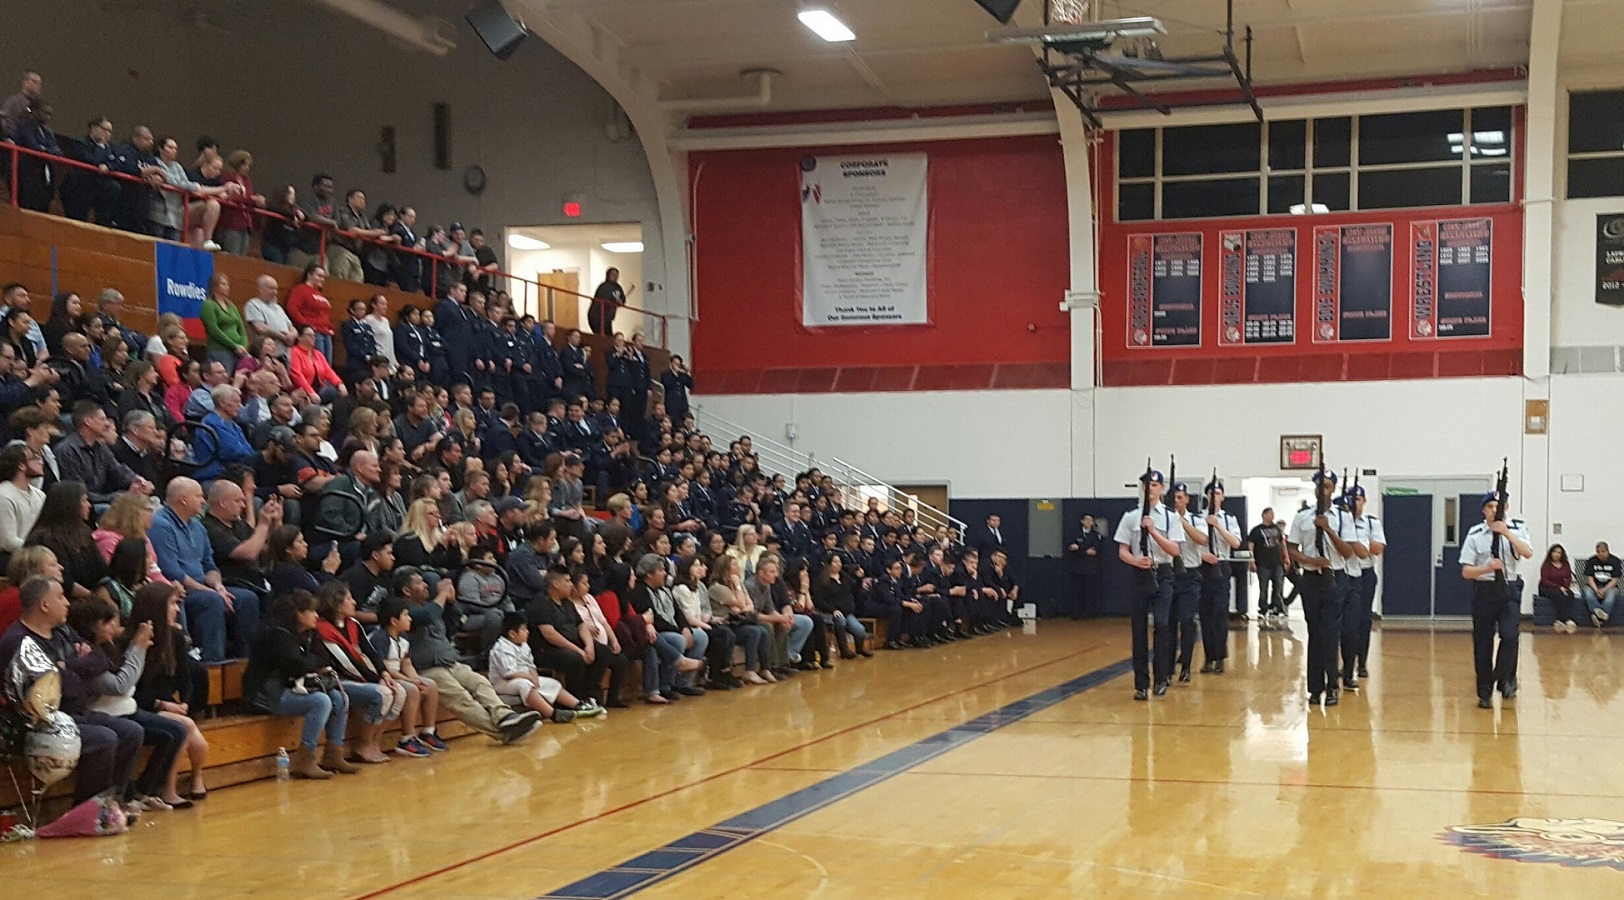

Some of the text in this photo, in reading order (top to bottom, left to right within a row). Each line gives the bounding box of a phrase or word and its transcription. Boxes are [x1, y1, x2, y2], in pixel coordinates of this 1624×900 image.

[840, 159, 889, 169] CORPORATE
[842, 169, 887, 178] SPONSORS
[1415, 239, 1433, 320] WRESTLING
[166, 277, 207, 302] Rowdies
[834, 306, 854, 314] Thank
[827, 314, 839, 322] Our
[872, 313, 902, 321] Sponsors
